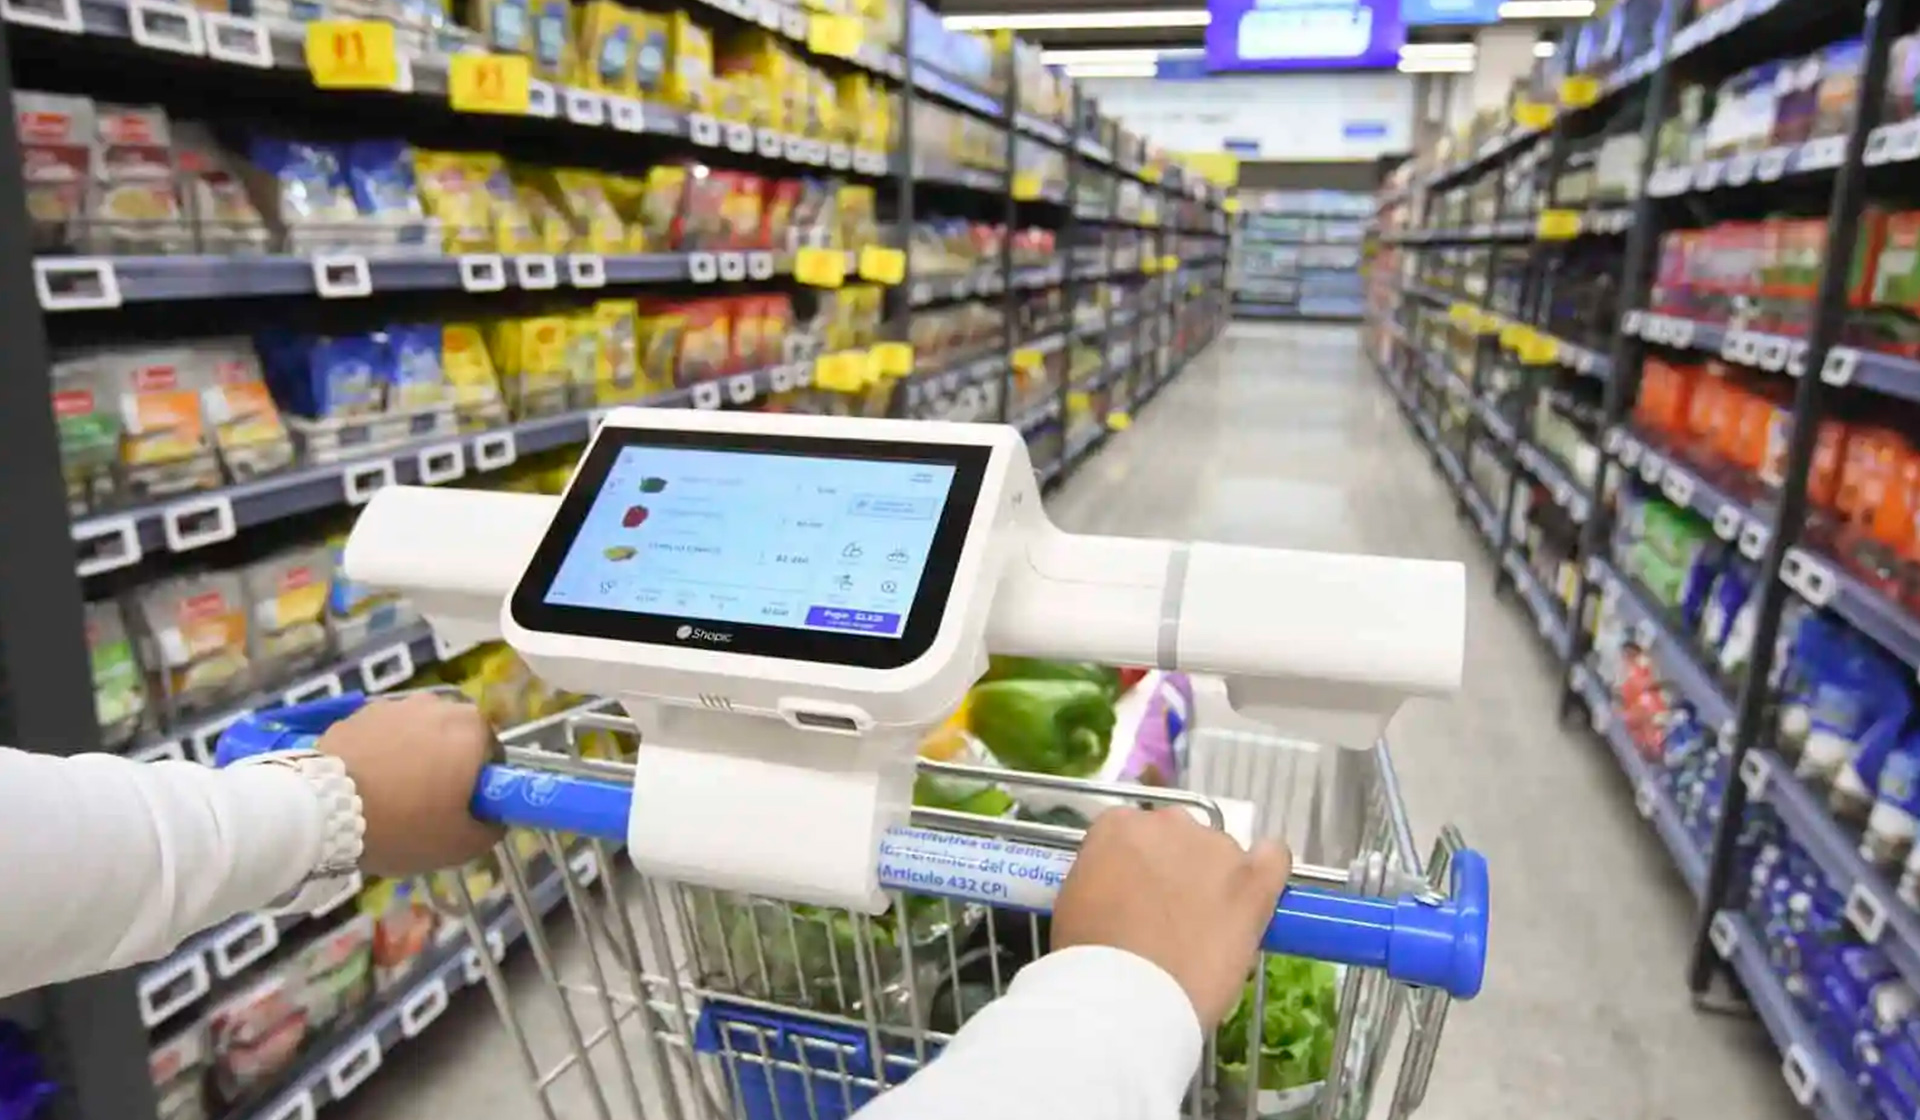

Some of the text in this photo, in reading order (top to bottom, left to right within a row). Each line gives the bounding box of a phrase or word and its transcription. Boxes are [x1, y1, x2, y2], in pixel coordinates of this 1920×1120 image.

[691, 627, 734, 644] Shopic
[979, 857, 1005, 874] del
[947, 874, 977, 893] 432
